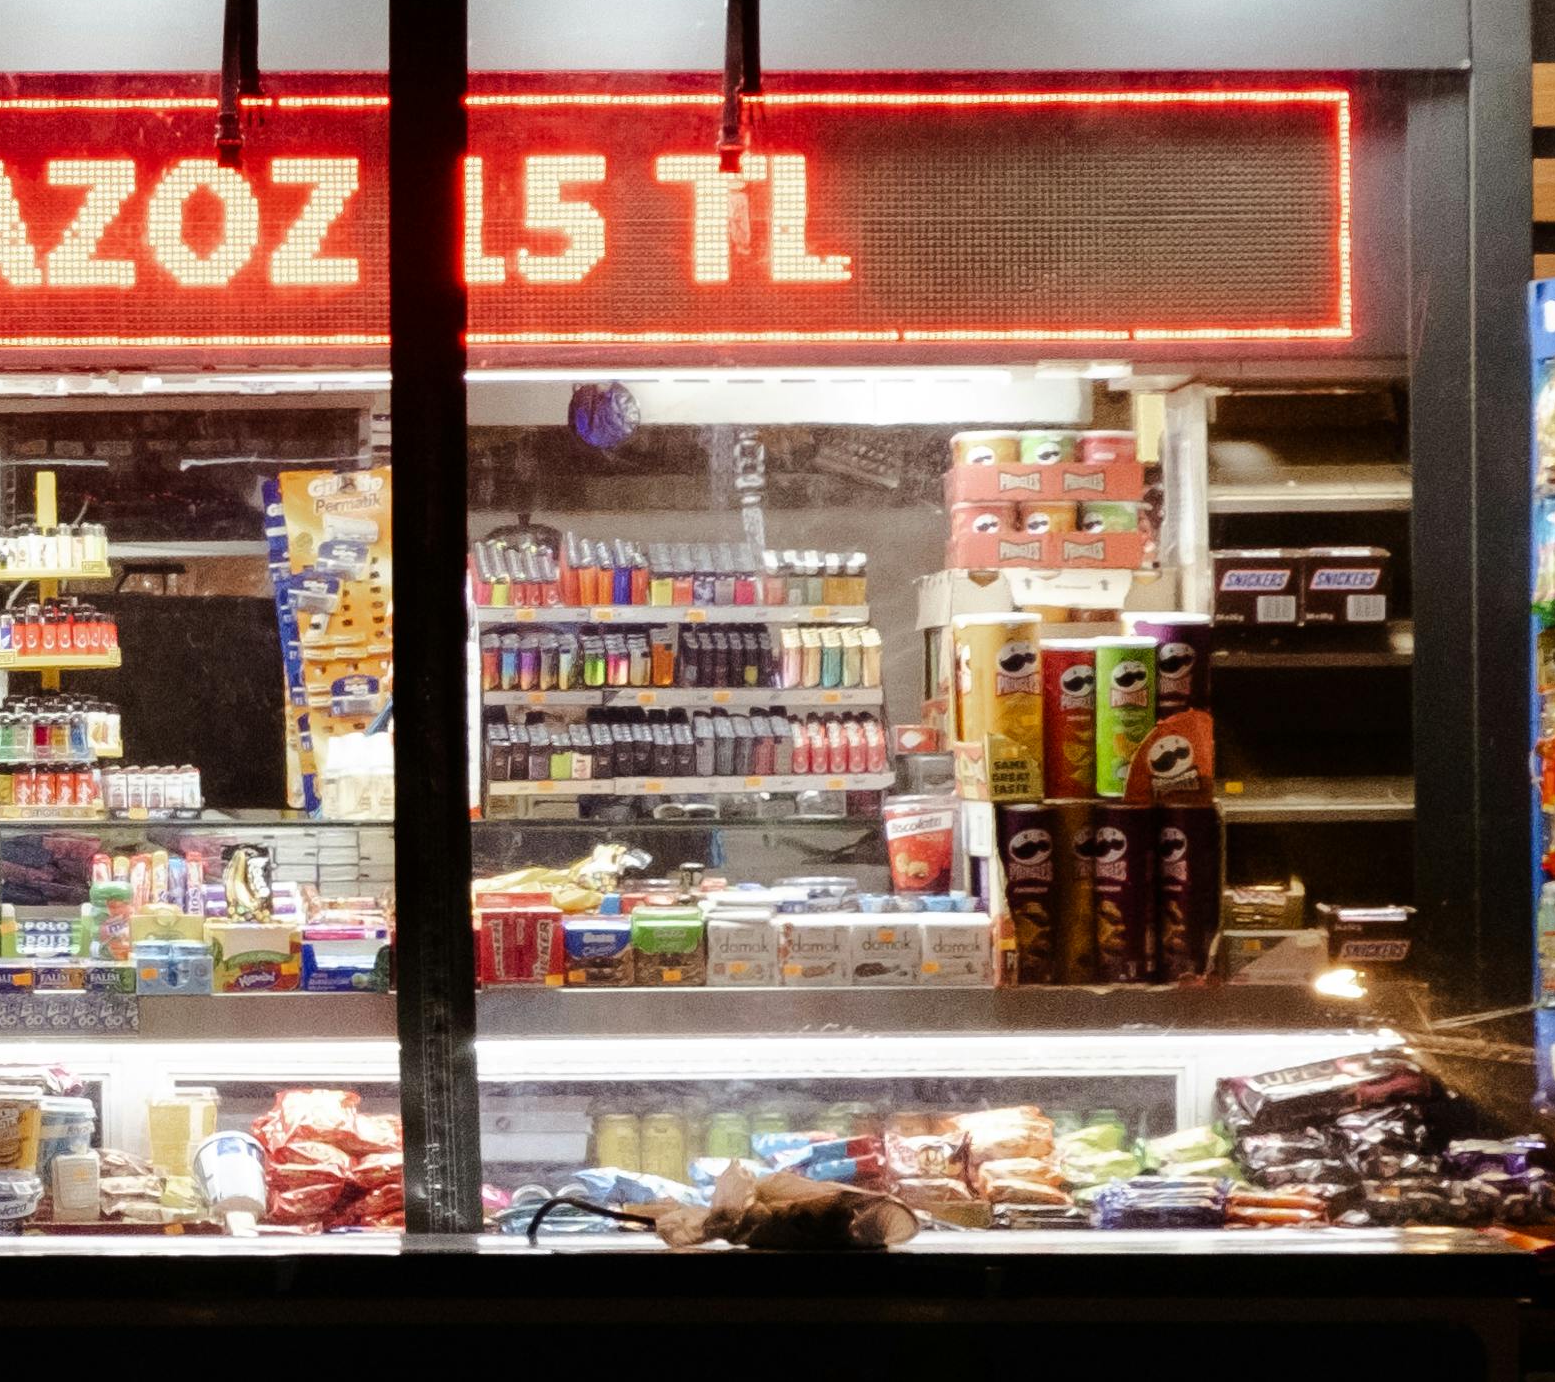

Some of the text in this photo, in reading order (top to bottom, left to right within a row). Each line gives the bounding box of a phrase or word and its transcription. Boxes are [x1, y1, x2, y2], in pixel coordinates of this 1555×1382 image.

[655, 154, 853, 283] TL
[315, 493, 381, 515] Permatik
[1225, 572, 1286, 587] SNICKERS
[1314, 571, 1377, 587] SNICKERS
[992, 784, 1031, 794] TASTE
[23, 920, 69, 932] POLO
[718, 934, 770, 954] damak
[792, 934, 840, 954] damak
[932, 934, 981, 954] damak
